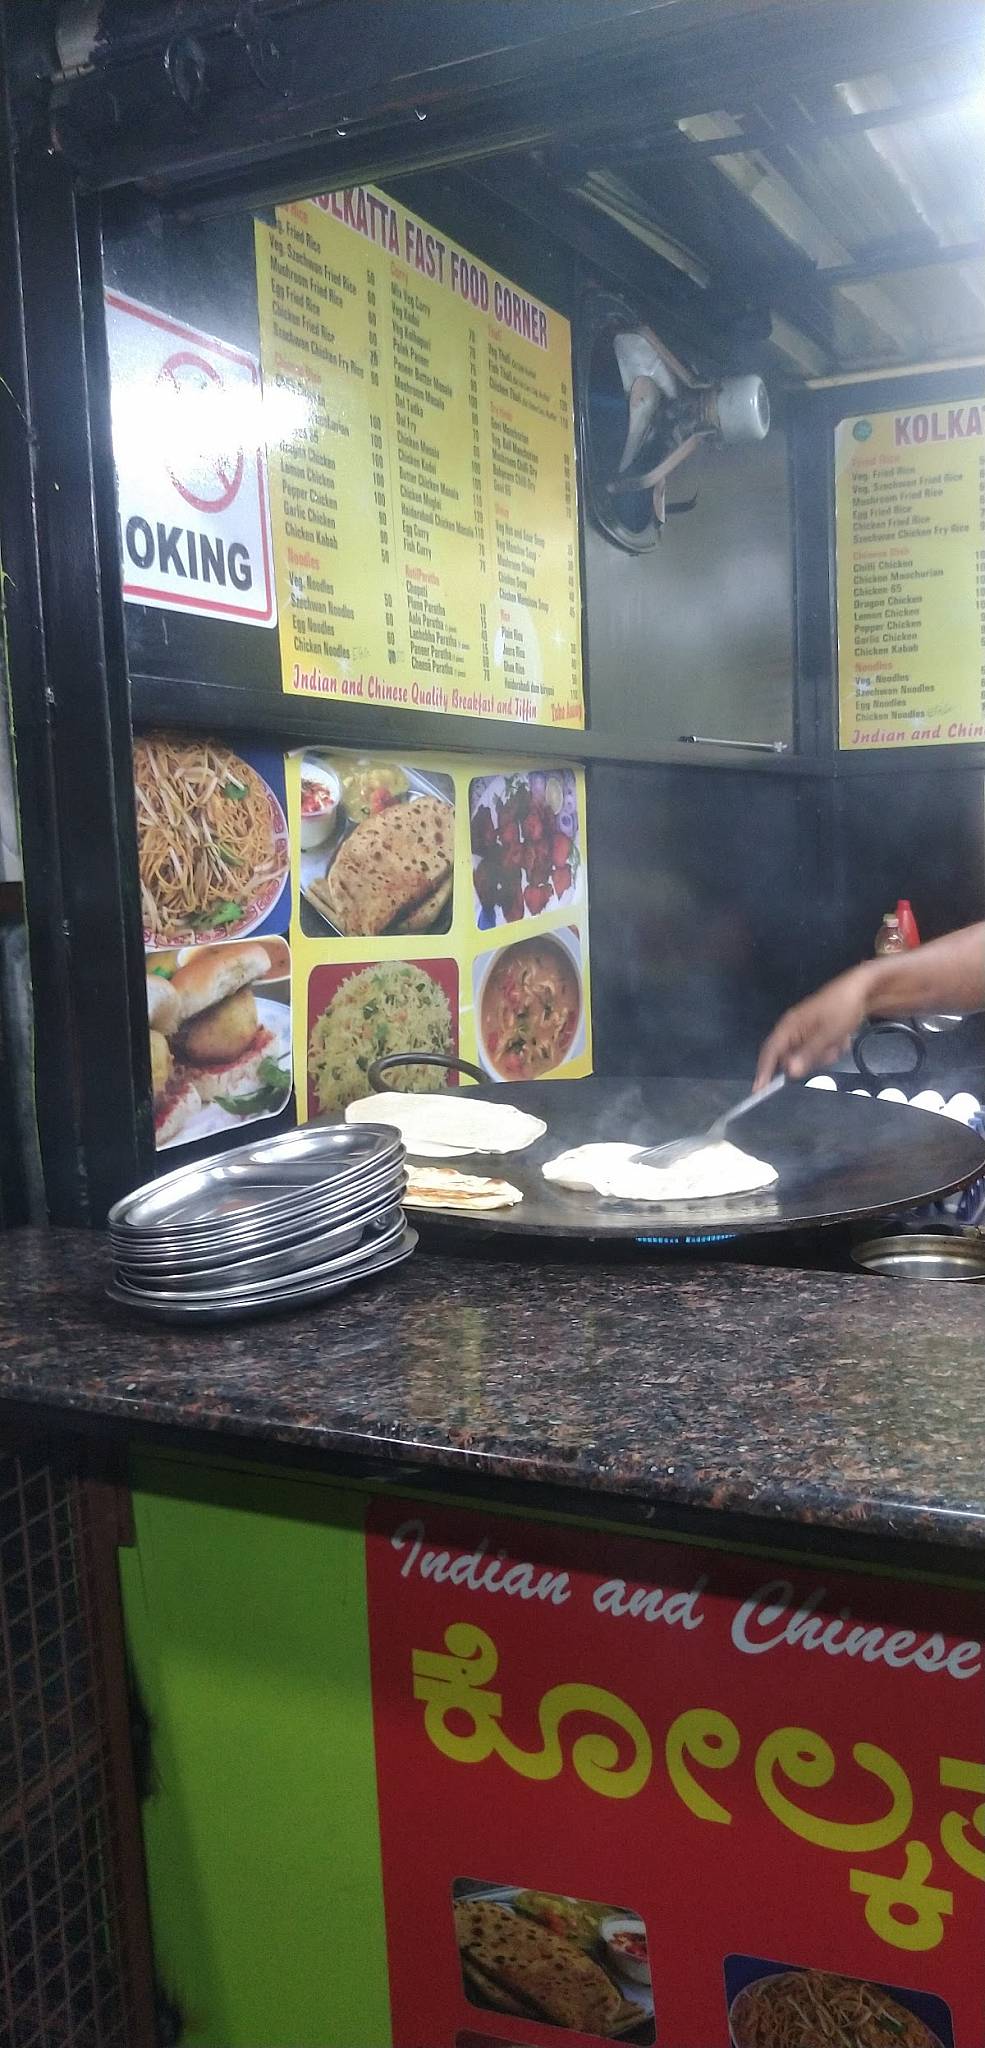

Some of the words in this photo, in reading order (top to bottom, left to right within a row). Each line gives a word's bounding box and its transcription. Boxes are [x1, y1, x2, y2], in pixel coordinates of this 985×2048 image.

[287, 222, 305, 246] Fried
[306, 233, 321, 255] Rice
[270, 256, 309, 290] Mushroom
[310, 278, 328, 301] Fried
[329, 288, 343, 310] Rice
[324, 265, 342, 288] Fried
[343, 276, 357, 297] Rice
[405, 219, 445, 284] FAST
[451, 251, 488, 311] FOOD
[494, 281, 547, 349] CORNER
[271, 279, 285, 301] Egg
[286, 287, 304, 309] Fried
[306, 296, 320, 317] Rice
[272, 300, 301, 328] Chicken
[302, 316, 320, 337] Fried
[321, 325, 336, 346] Rice
[311, 340, 338, 366] Chicken
[350, 360, 364, 379] Rice
[895, 406, 985, 446] KOLKA
[397, 431, 419, 451] Chicken
[308, 449, 335, 470] Chicken
[398, 449, 420, 468] Chicken
[281, 460, 305, 480] Lemon
[307, 468, 335, 490] Chicken
[873, 467, 894, 478] Fried
[897, 466, 915, 475] Rice
[920, 474, 941, 485] Fried
[944, 473, 963, 482] Rice
[418, 475, 440, 493] Chicken
[282, 480, 307, 503] Pepper
[309, 490, 337, 510] Chicken
[400, 485, 422, 504] Chicken
[852, 494, 897, 507] Mushroom
[900, 490, 922, 501] Fried
[924, 487, 943, 497] Rice
[283, 501, 306, 521] Garlic
[307, 509, 336, 529] Chicken
[852, 511, 868, 521] Egg
[870, 507, 891, 518] Fried
[893, 505, 912, 514] Rice
[852, 520, 886, 531] Chicken
[889, 517, 910, 528] Fried
[912, 515, 930, 525] Rice
[285, 521, 314, 542] Chicken
[402, 521, 413, 538] Egg
[414, 525, 429, 544] Curry
[435, 515, 455, 532] Chicken
[898, 528, 932, 539] Chicken
[934, 526, 948, 536] Fry
[950, 523, 970, 533] Rice
[122, 516, 252, 591] OKING
[288, 548, 320, 571] Noodles
[404, 539, 415, 553] Fish
[416, 543, 432, 561] Curry
[878, 560, 913, 570] Chicken
[853, 574, 887, 585] Chicken
[306, 576, 334, 596] Noodles
[384, 594, 392, 608] 50
[853, 586, 887, 597] Chicken
[328, 602, 354, 620] Noodles
[853, 598, 885, 609] Dragon
[887, 595, 923, 605] Chicken
[854, 611, 882, 621] Lemon
[884, 607, 919, 618] Chicken
[292, 615, 306, 634] Egg
[308, 618, 334, 636] Noodles
[854, 623, 885, 634] Pepper
[887, 620, 922, 630] Chicken
[294, 637, 322, 655] Chicken
[324, 642, 350, 660] Noodles
[854, 635, 880, 645] Garlic
[882, 632, 917, 642] Chicken
[854, 647, 888, 657] Chicken
[855, 661, 893, 672] Noodles
[875, 673, 909, 684] Noodles
[293, 664, 337, 692] Indian
[341, 675, 363, 696] and
[367, 675, 408, 702] Chinese
[411, 682, 447, 711] Quality
[451, 688, 494, 714] Breakfast
[496, 696, 512, 715] and
[515, 698, 537, 720] Tiffin
[901, 684, 935, 694] Noodles
[855, 701, 871, 711] Egg
[873, 699, 906, 709] Noodles
[855, 712, 888, 722] Chicken
[891, 709, 925, 719] Noodles
[852, 729, 905, 745] Indian
[911, 724, 940, 740] and
[947, 722, 985, 739] Chin
[390, 1519, 571, 1605] Indian
[592, 1575, 704, 1630] and
[731, 1580, 981, 1680] Chinese
